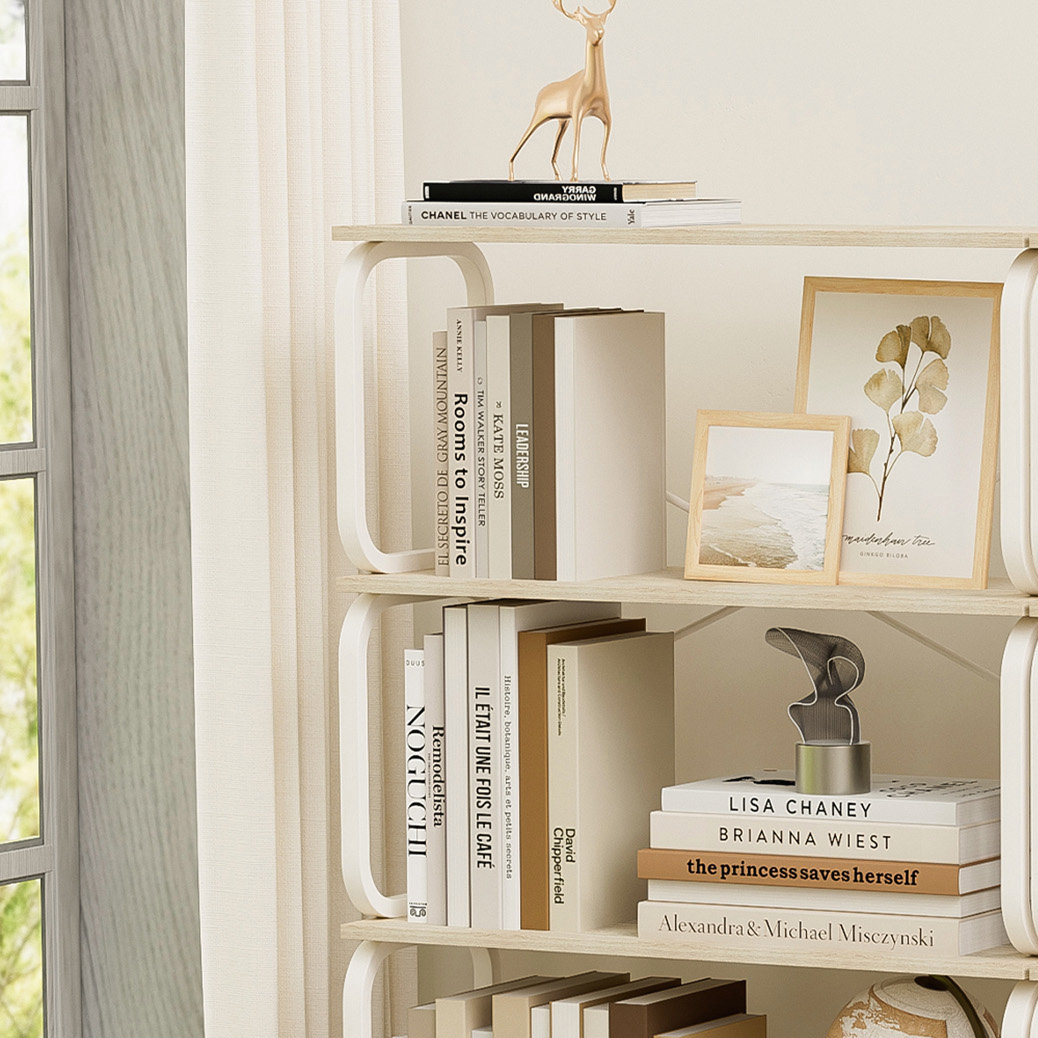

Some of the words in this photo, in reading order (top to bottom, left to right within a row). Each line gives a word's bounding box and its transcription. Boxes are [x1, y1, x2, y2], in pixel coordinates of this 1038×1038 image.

[421, 210, 468, 220] CHANEL
[470, 212, 488, 220] THE
[491, 212, 558, 220] VOCABULARY
[560, 212, 574, 220] OF
[577, 212, 606, 220] STYLE
[455, 394, 468, 461] Rooms
[494, 415, 503, 453] KATE
[516, 424, 529, 487] LEADERSHIP
[455, 468, 468, 488] to
[494, 458, 504, 498] MOSS
[451, 497, 470, 565] Inspire
[475, 688, 490, 699] IL
[476, 704, 493, 742] ÉTAIT
[433, 727, 444, 826] Remodelista
[476, 747, 491, 774] UNE
[407, 706, 426, 855] NOGUCHI
[476, 779, 491, 809] FOIS
[477, 813, 491, 829] LE
[730, 797, 774, 813] LISA
[787, 800, 871, 817] CHANEY
[477, 834, 495, 868] CAFÉ
[566, 829, 575, 862] David
[720, 828, 816, 845] BRIANNA
[828, 833, 890, 849] WIEST
[552, 828, 564, 904] Chipperfield
[687, 859, 717, 882] the
[720, 861, 797, 887] princess
[800, 869, 850, 882] saves
[853, 862, 919, 885] herself
[658, 914, 745, 937] Alexandra
[747, 921, 762, 938] &
[763, 920, 833, 942] Michael
[838, 923, 935, 950] Misczynski
